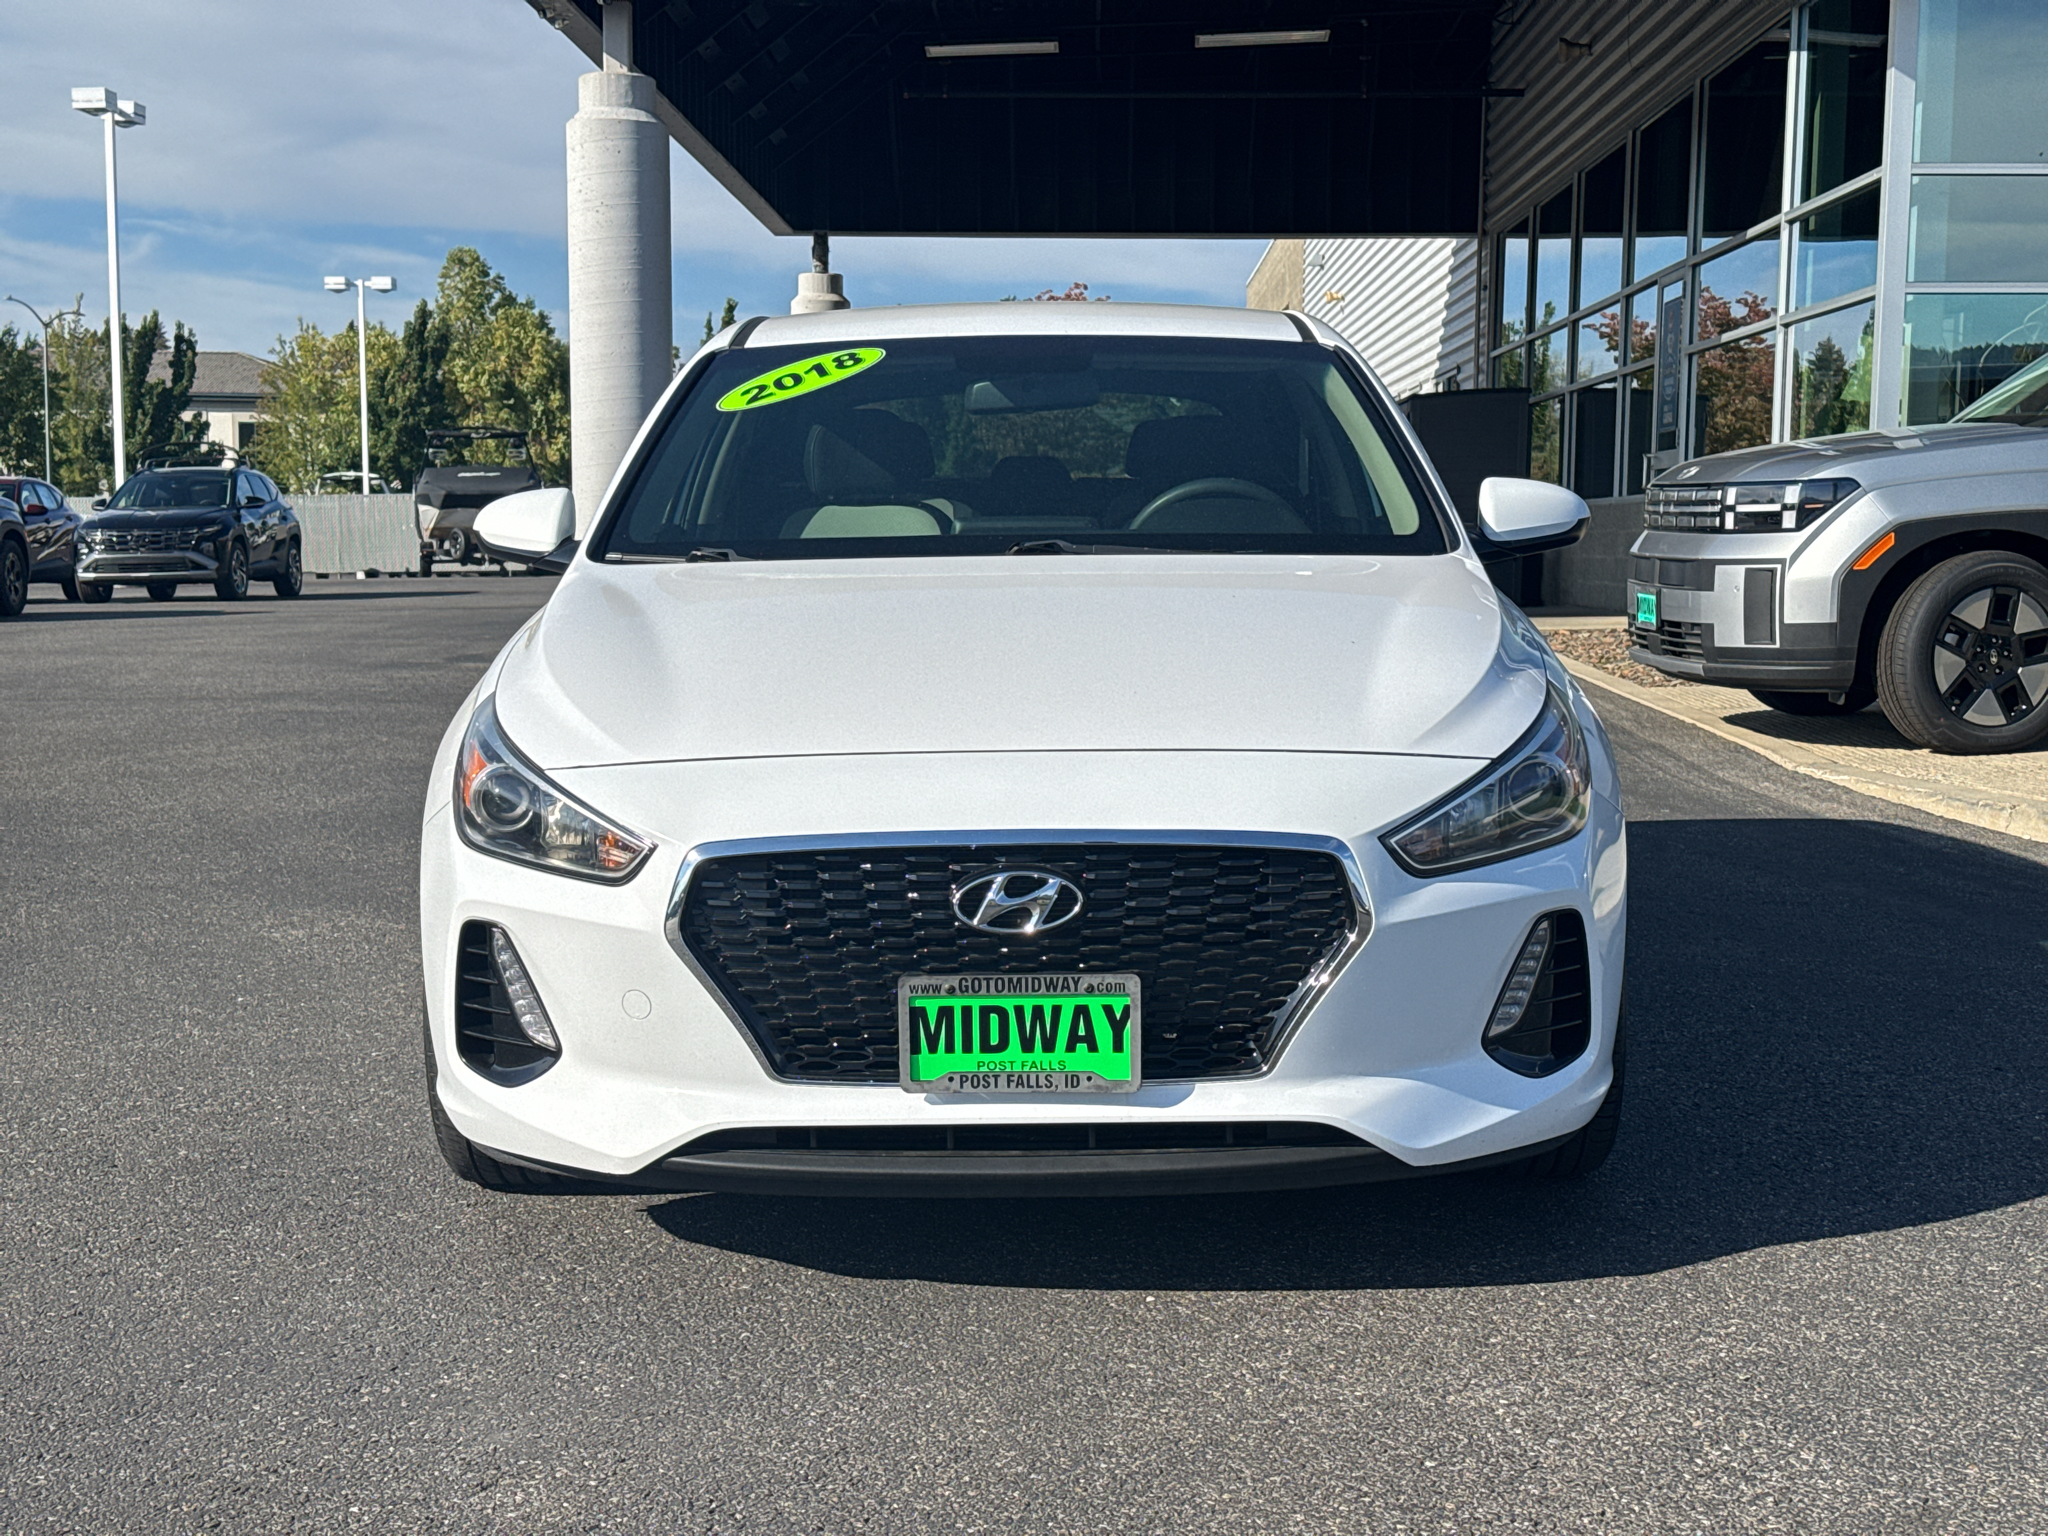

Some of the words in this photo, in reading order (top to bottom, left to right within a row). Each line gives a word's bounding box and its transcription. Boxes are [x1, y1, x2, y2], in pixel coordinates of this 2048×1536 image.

[740, 353, 863, 405] 2018
[958, 977, 1082, 993] GOTOMIDWAY
[910, 1004, 1130, 1054] MIDWAY
[977, 1060, 1016, 1070] POST
[1021, 1060, 1067, 1070] FALLS
[960, 1075, 1001, 1089] POST
[1006, 1074, 1059, 1090] FALLS,
[1064, 1074, 1080, 1088] ID
